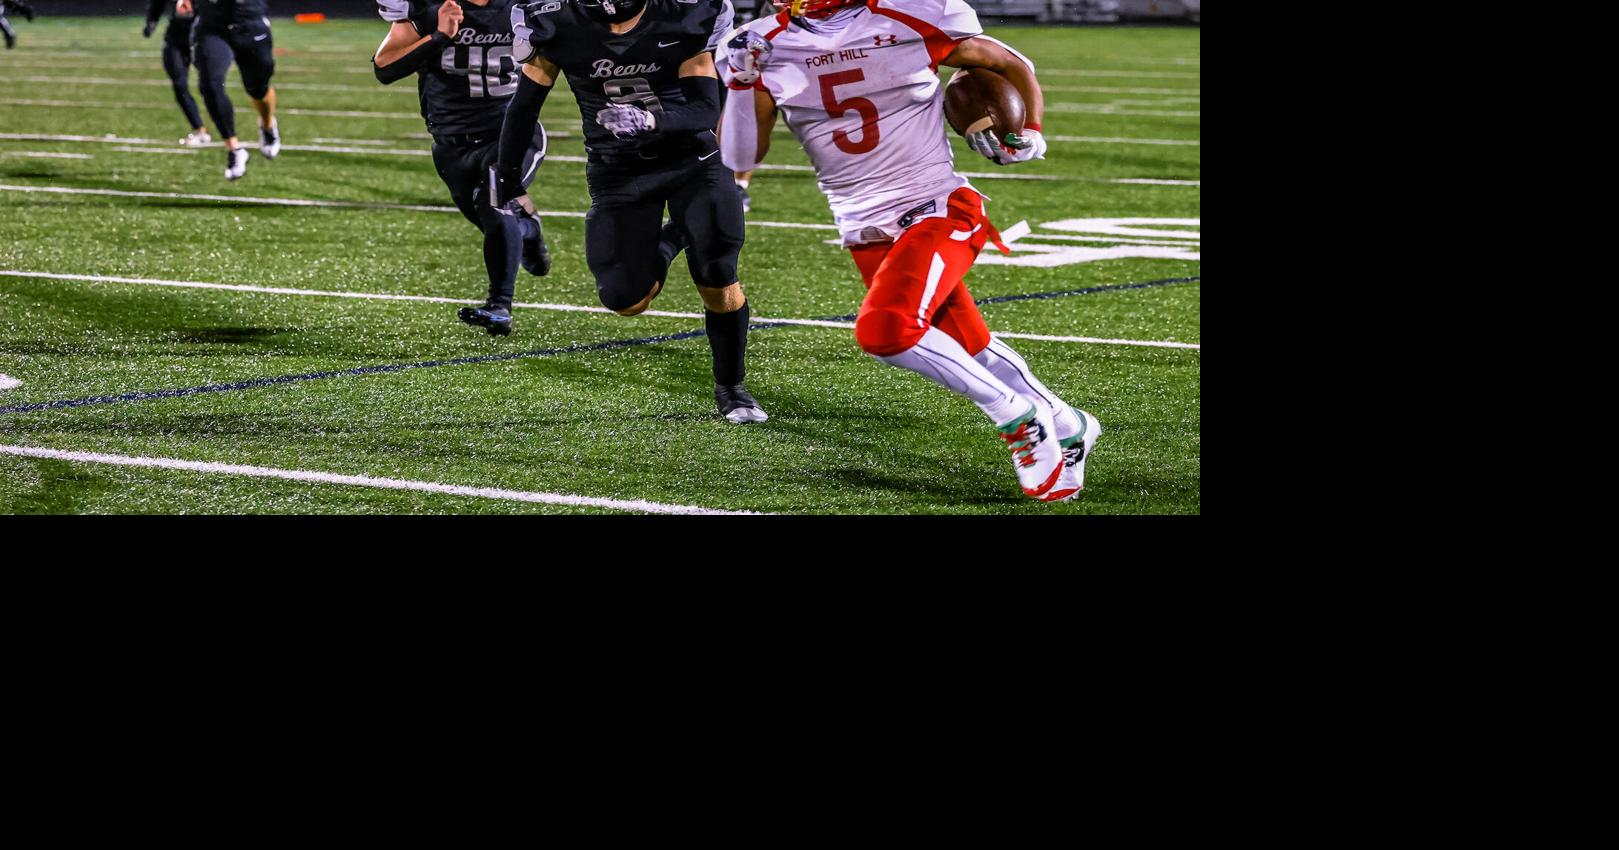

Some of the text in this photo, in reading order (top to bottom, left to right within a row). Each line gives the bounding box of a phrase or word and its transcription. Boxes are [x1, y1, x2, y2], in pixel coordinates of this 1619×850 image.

[455, 27, 514, 45] Bears
[589, 58, 661, 78] Bears
[805, 48, 869, 69] FORT HILL
[818, 67, 880, 155] 5
